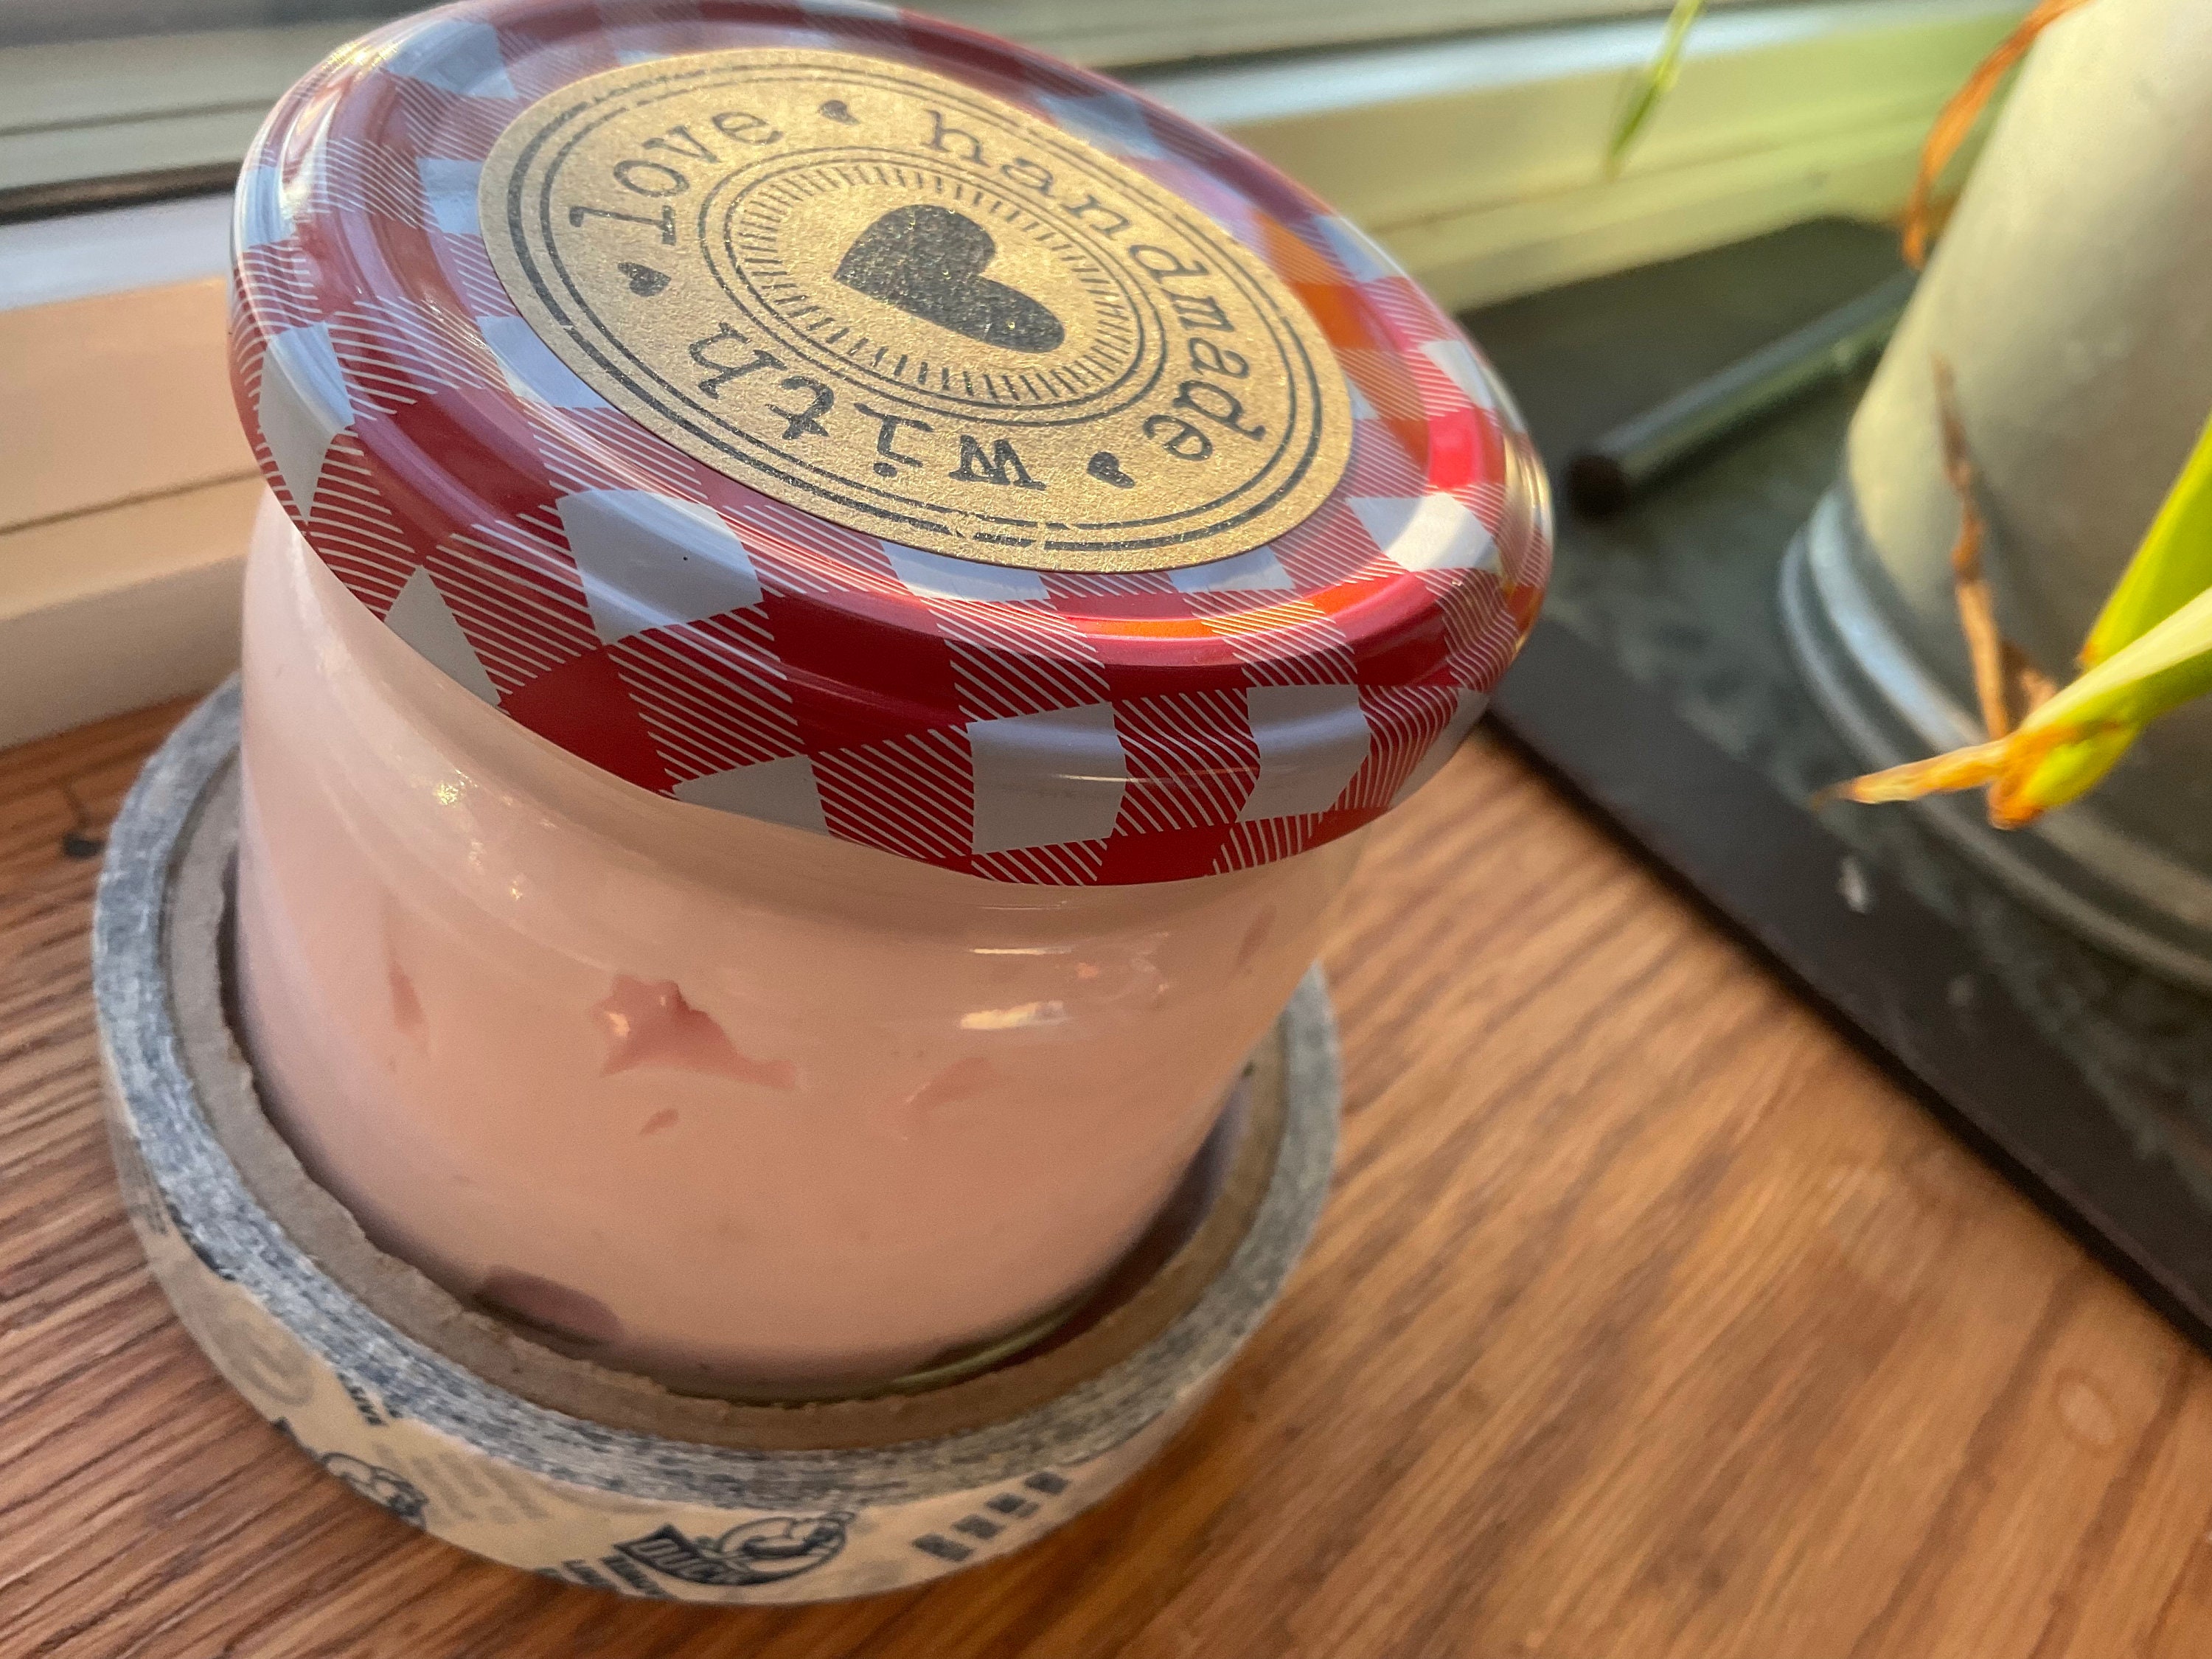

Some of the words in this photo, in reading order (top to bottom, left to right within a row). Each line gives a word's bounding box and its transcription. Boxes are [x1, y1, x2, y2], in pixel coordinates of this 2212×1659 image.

[569, 111, 785, 246] love
[921, 108, 1265, 462] handmade
[689, 321, 1047, 491] with
